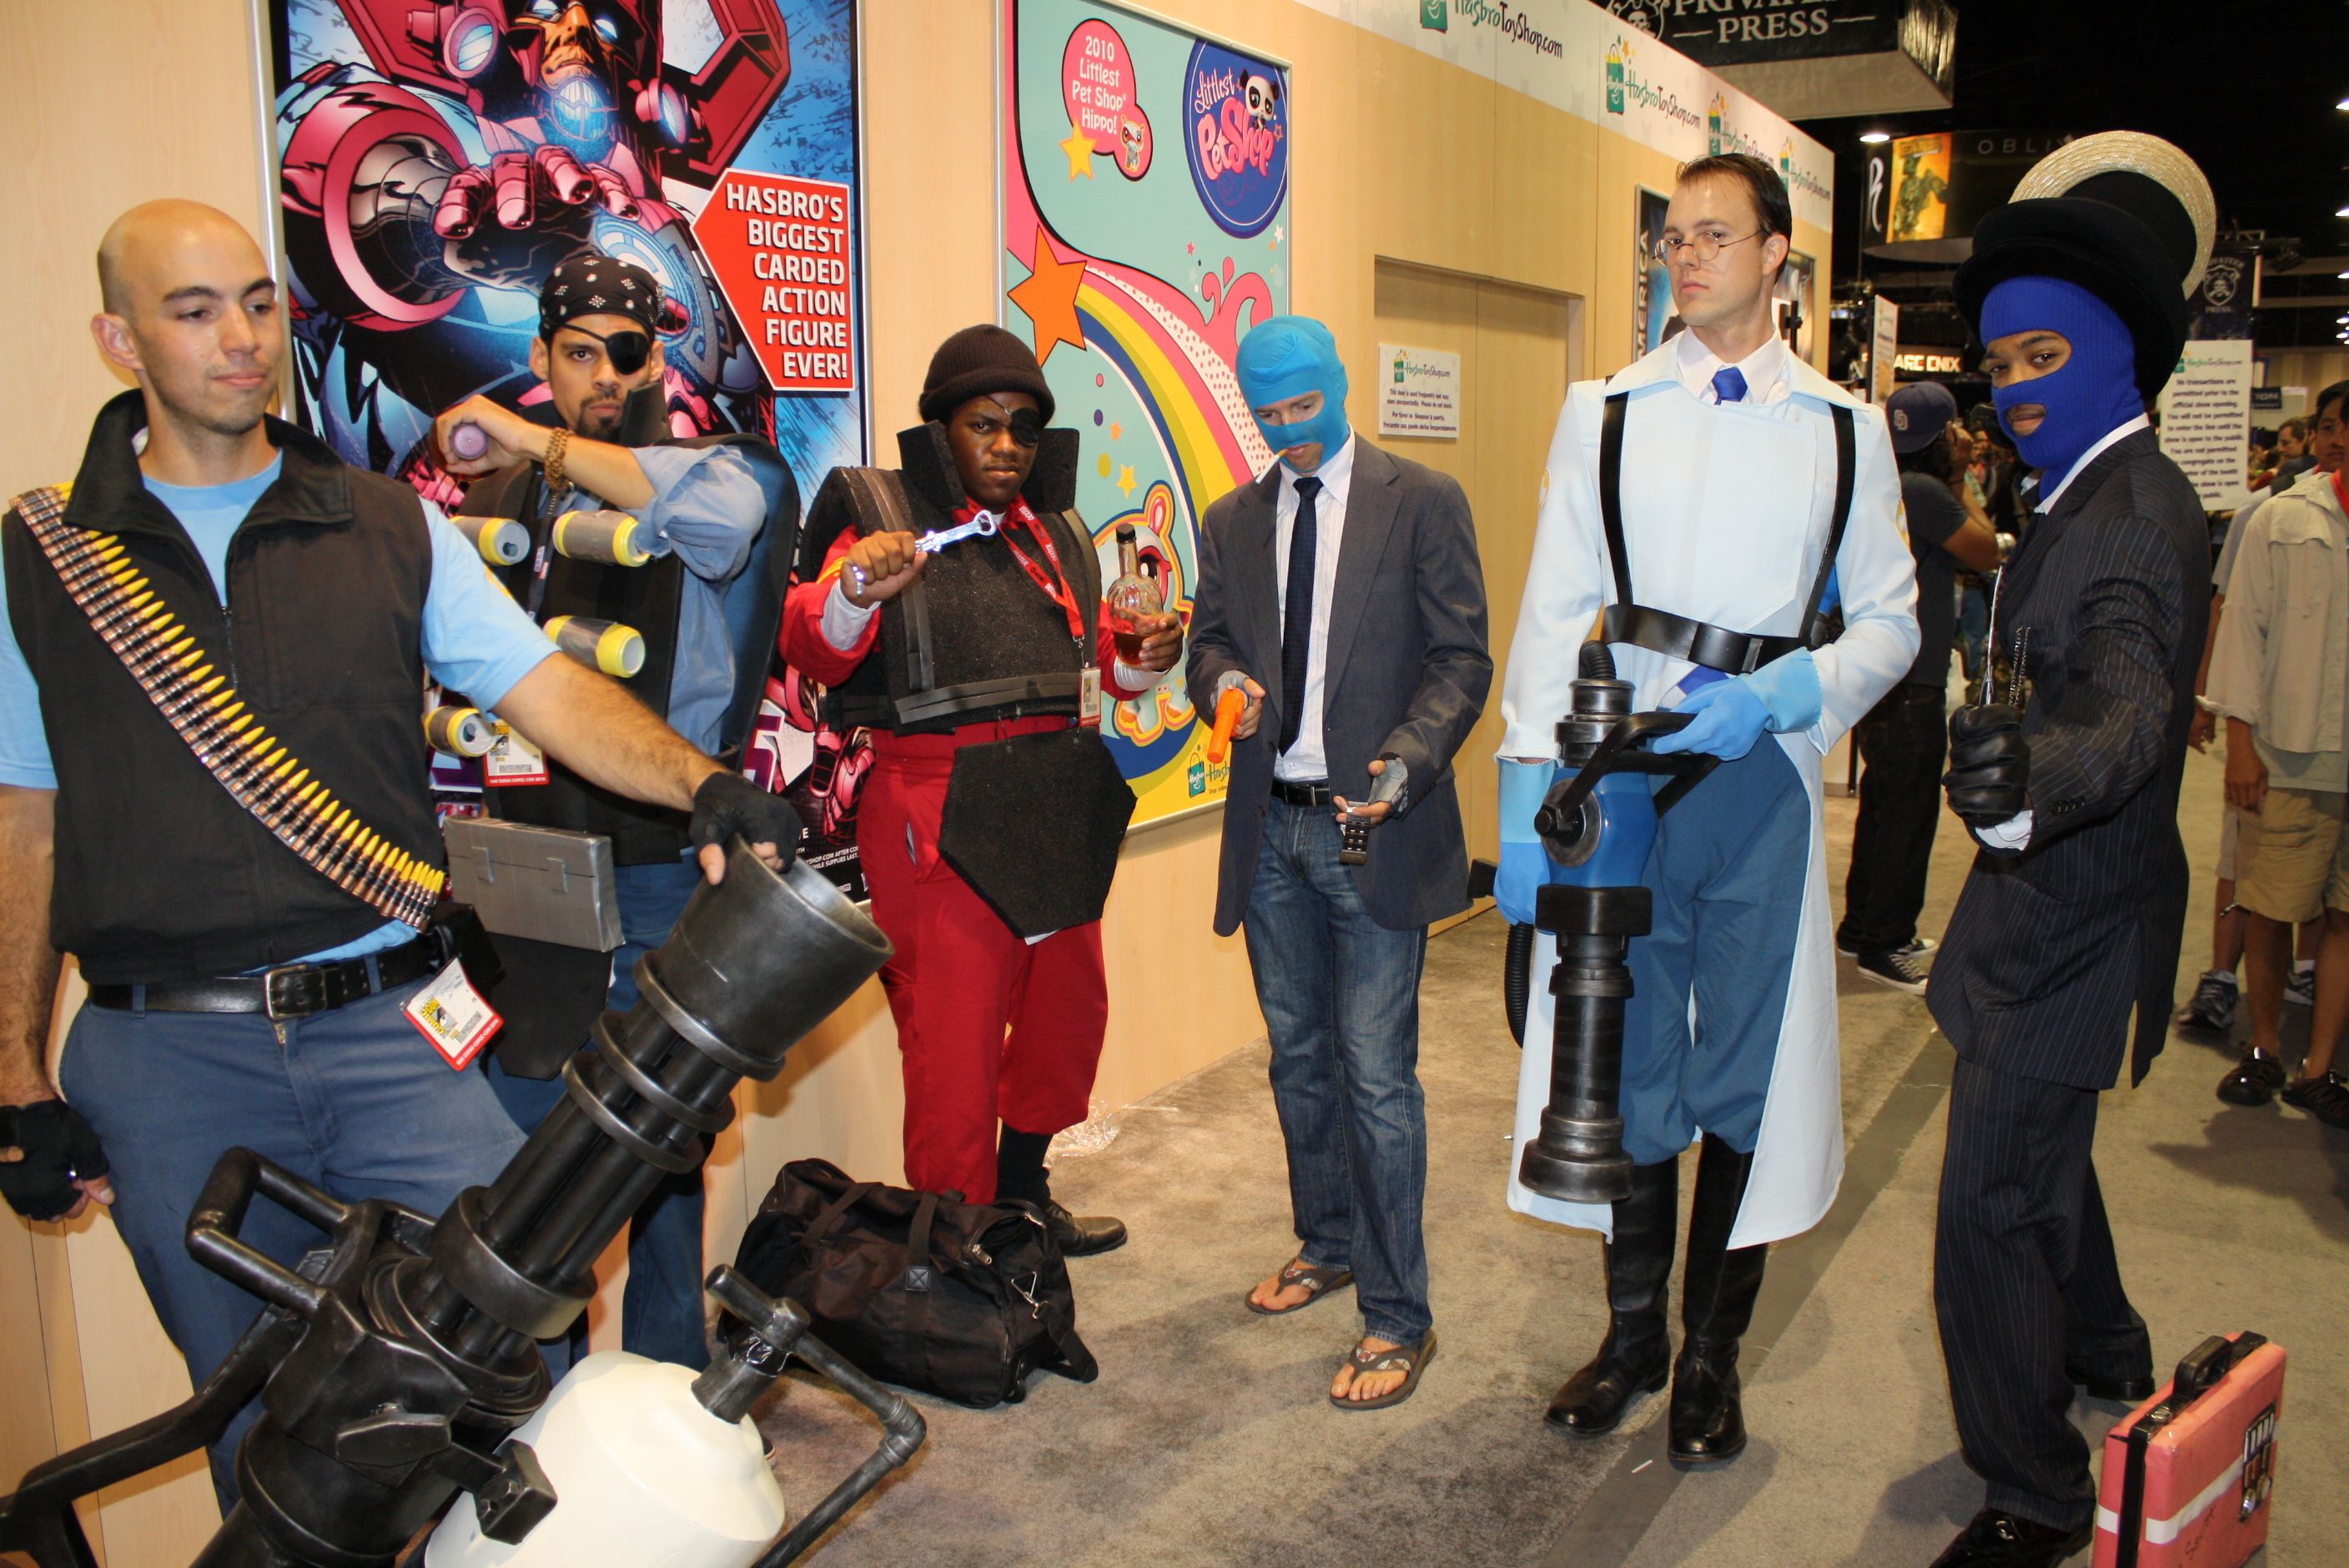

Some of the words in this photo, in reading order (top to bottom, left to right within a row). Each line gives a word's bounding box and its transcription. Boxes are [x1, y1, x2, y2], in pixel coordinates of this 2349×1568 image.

[1718, 8, 1828, 43] PRESS
[1085, 35, 1114, 62] 2010
[1080, 58, 1119, 88] Littlest
[1072, 80, 1092, 103] Pet
[1195, 68, 1235, 113] Littlest
[1625, 69, 1700, 129] HasbroToyShop.com
[1082, 107, 1118, 134] Hippo!
[1197, 113, 1232, 180] Pet
[1221, 97, 1275, 178] Shop
[727, 183, 843, 222] HASBRO'S
[748, 219, 843, 254] BIGGEST
[755, 252, 844, 284] CARDED
[762, 286, 846, 316] ACTION
[767, 319, 847, 347] FIGURE
[783, 352, 847, 379] EVER!
[826, 857, 846, 866] SUPPLIES
[835, 848, 848, 857] AFTER
